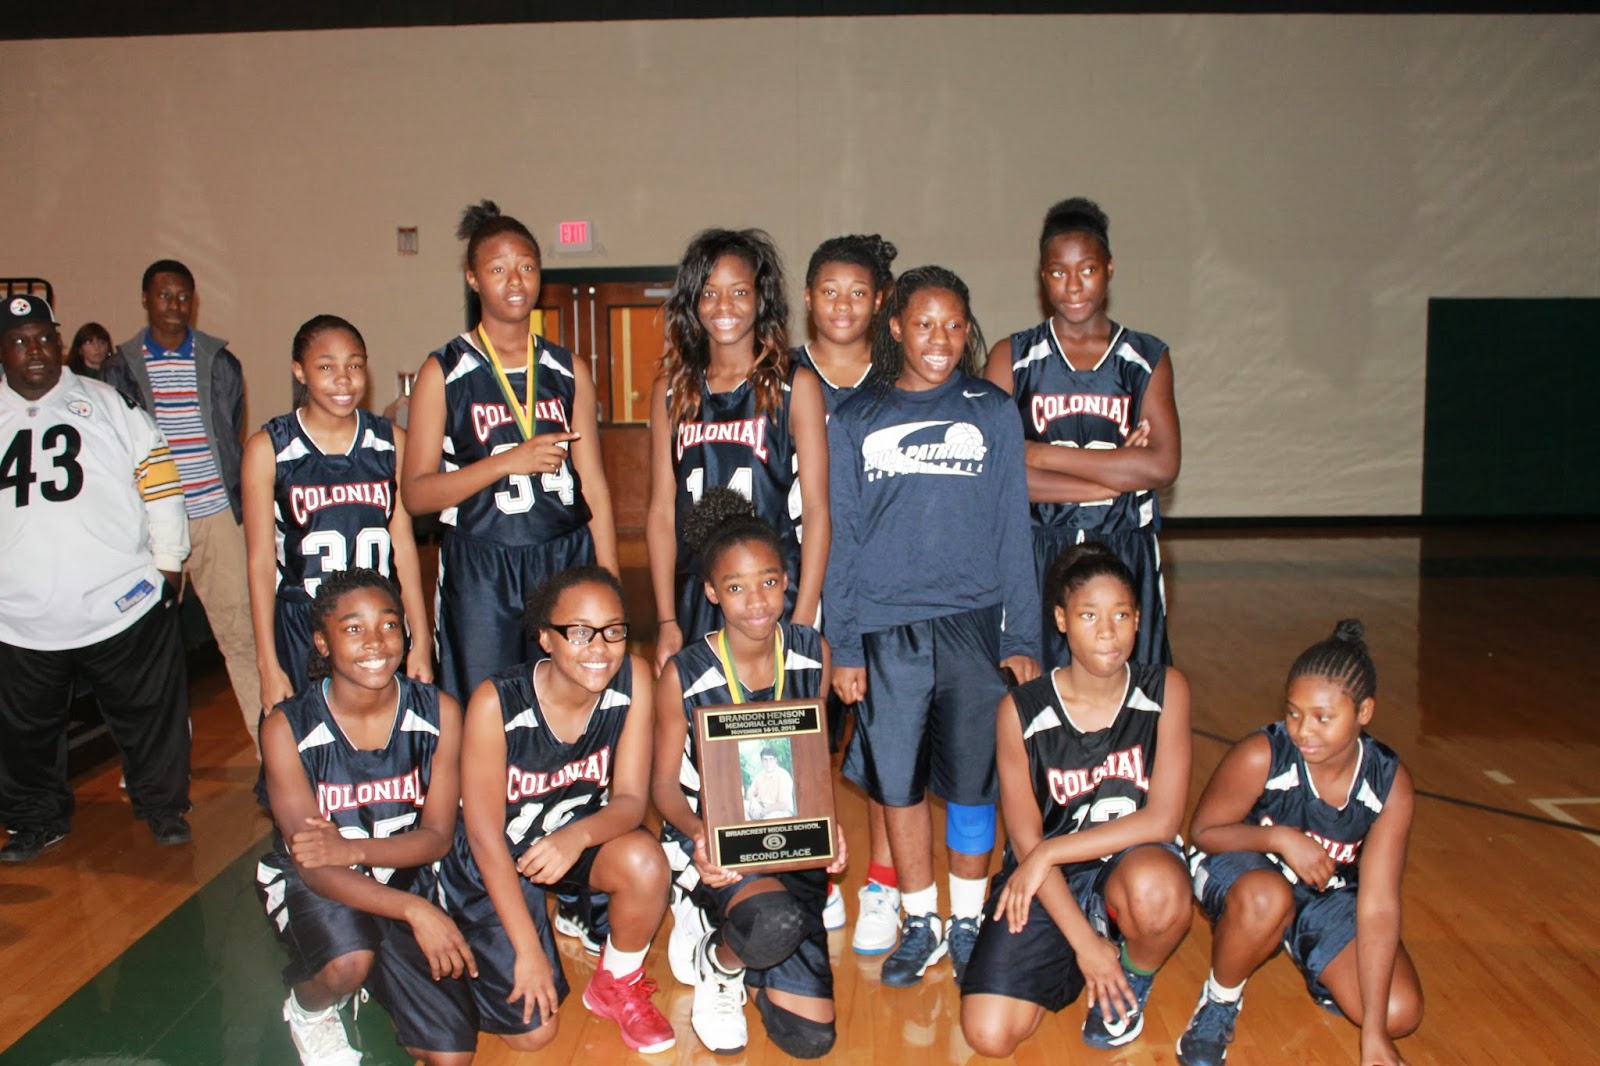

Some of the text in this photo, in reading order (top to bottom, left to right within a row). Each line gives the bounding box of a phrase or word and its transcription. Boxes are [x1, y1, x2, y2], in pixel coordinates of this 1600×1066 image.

[561, 223, 587, 244] EXIT
[471, 397, 571, 444] COLIAL
[1031, 393, 1132, 438] COLONIAL
[677, 416, 769, 464] COLONIAL
[904, 442, 988, 463] PATRIOTS
[0, 424, 84, 508] 43
[494, 441, 575, 515] 34
[290, 480, 392, 527] COLONIAL
[719, 709, 806, 723] BRANDON HENSON
[725, 717, 800, 730] MEMORIAL CLASSIC
[316, 764, 426, 822] COLONIAL
[725, 822, 821, 838] BRIARCREST MIDDLE SCHOOL
[739, 848, 812, 862] SECOND PLACE
